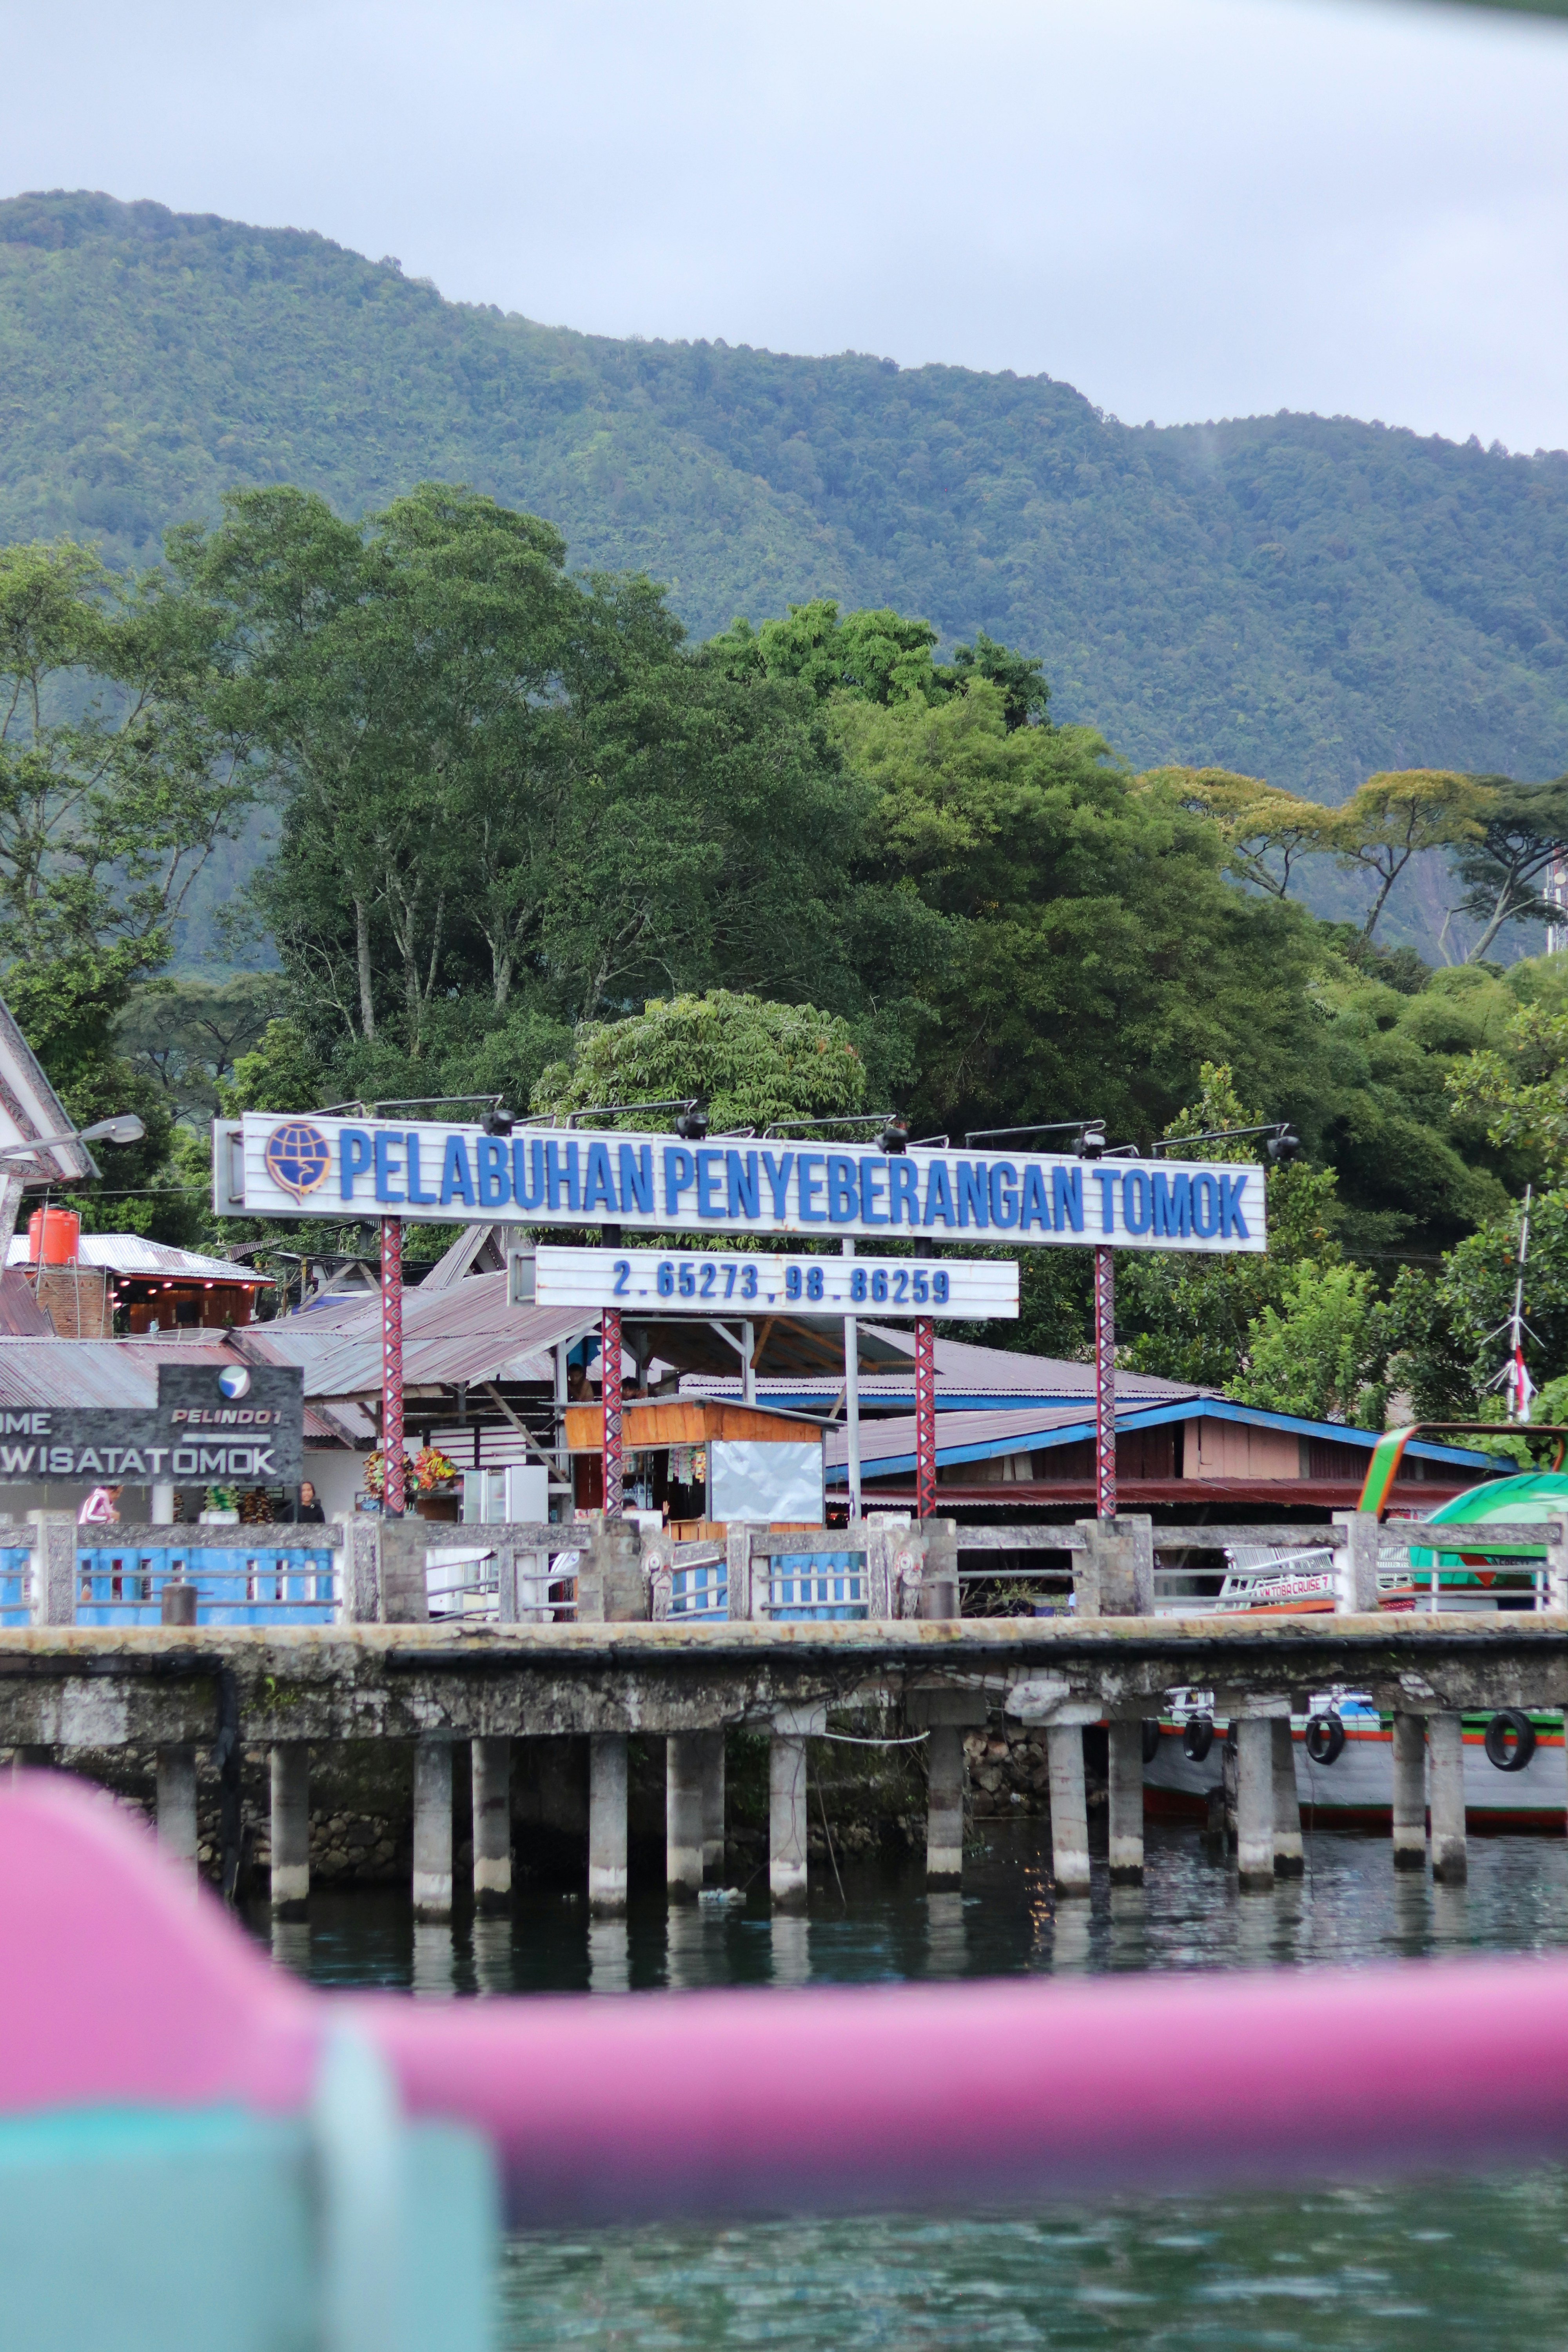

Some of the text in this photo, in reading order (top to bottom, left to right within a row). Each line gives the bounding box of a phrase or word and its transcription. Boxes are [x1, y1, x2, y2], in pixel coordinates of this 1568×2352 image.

[339, 1129, 1250, 1239] PELABUHAN PENYEBERANGAN TOMOK
[0, 1413, 52, 1435] ME
[171, 1409, 271, 1424] PELINDO
[1272, 1584, 1293, 1597] TOBA
[1292, 1577, 1321, 1595] CRUISE
[1322, 1575, 1328, 1589] 7
